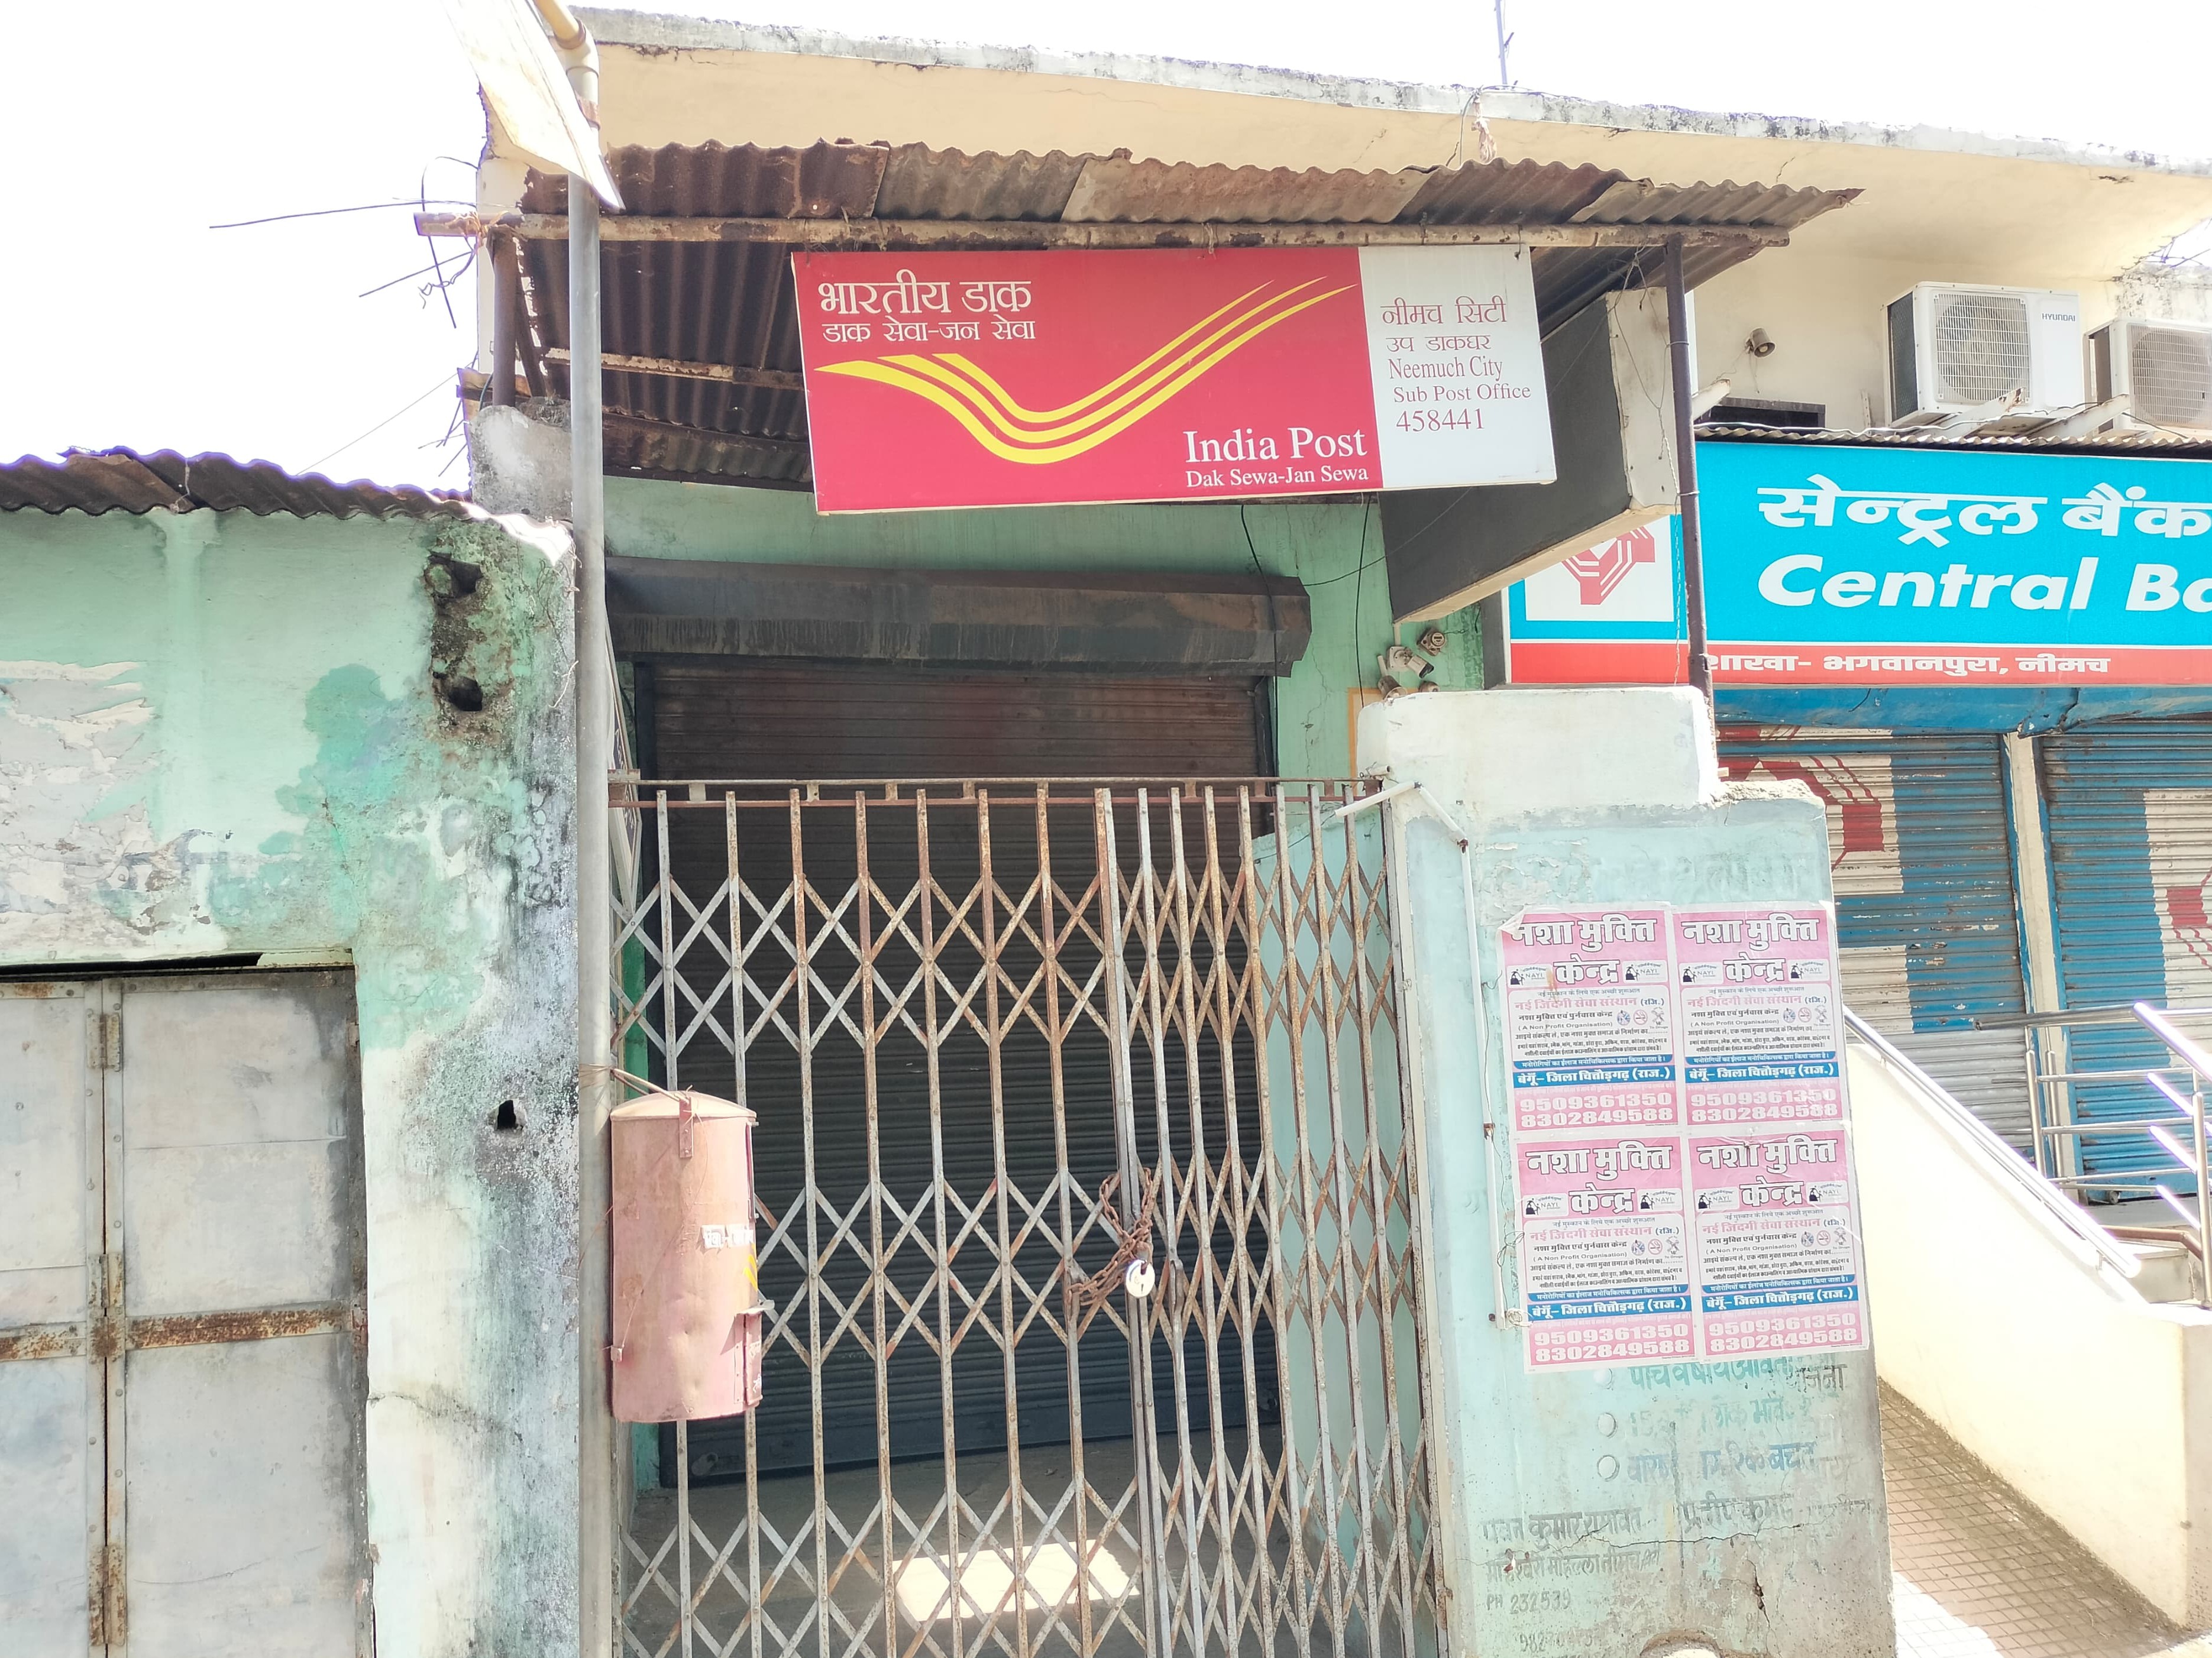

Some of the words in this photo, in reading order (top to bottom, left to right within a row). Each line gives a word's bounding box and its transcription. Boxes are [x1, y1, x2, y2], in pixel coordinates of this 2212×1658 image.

[819, 270, 951, 314] भारतीय
[959, 281, 1031, 315] डाक
[1380, 297, 1443, 325] नीमच
[1455, 296, 1506, 323] सिटी
[822, 324, 870, 342] डाक
[882, 316, 980, 341] सेवा-जन
[991, 314, 1035, 339] सेवा
[1386, 337, 1414, 352] उप
[1425, 335, 1491, 351] डाकघर
[1388, 357, 1465, 378] Neemuch
[1470, 356, 1502, 381] City
[1394, 386, 1427, 402] Sub
[1433, 386, 1471, 401] Post
[1477, 380, 1531, 399] Office
[1396, 409, 1483, 432] 458441
[1183, 429, 1279, 462] India
[1288, 428, 1367, 458] Post
[1186, 470, 1224, 487] Dak
[1230, 467, 1315, 485] Sewa-Jan
[1321, 465, 1369, 481] Sewa
[1757, 474, 2048, 548] सेन्ट्रल
[2062, 482, 2212, 538] बैंक
[1758, 555, 2098, 610] Central
[1824, 656, 2008, 676] भगवानपुरा,
[2015, 653, 2111, 672] नीमच
[1511, 920, 1574, 946] नशा
[1577, 912, 1657, 952] मुक्ति
[1681, 919, 1743, 944] नशा
[1745, 912, 1820, 951] मुक्ति
[1553, 953, 1620, 985] केन्द्र
[1722, 951, 1786, 983] केन्द्र
[1520, 1092, 1672, 1111] 9509361350
[1693, 1088, 1835, 1106] 9509361350
[1521, 1108, 1674, 1127] 8302849588
[1694, 1103, 1837, 1122] 8302849588
[1524, 1148, 1590, 1175] नशा
[1593, 1139, 1673, 1181] मुक्ति
[1696, 1142, 1760, 1169] नशा
[1762, 1134, 1839, 1174] मुक्ति
[1568, 1181, 1635, 1215] केन्द्र
[1739, 1175, 1804, 1207] केन्द्र
[1534, 1324, 1687, 1345] 9509361350
[1709, 1313, 1855, 1336] 9509361350
[1535, 1339, 1689, 1361] 8302849588
[1710, 1327, 1857, 1352] 8302849588
